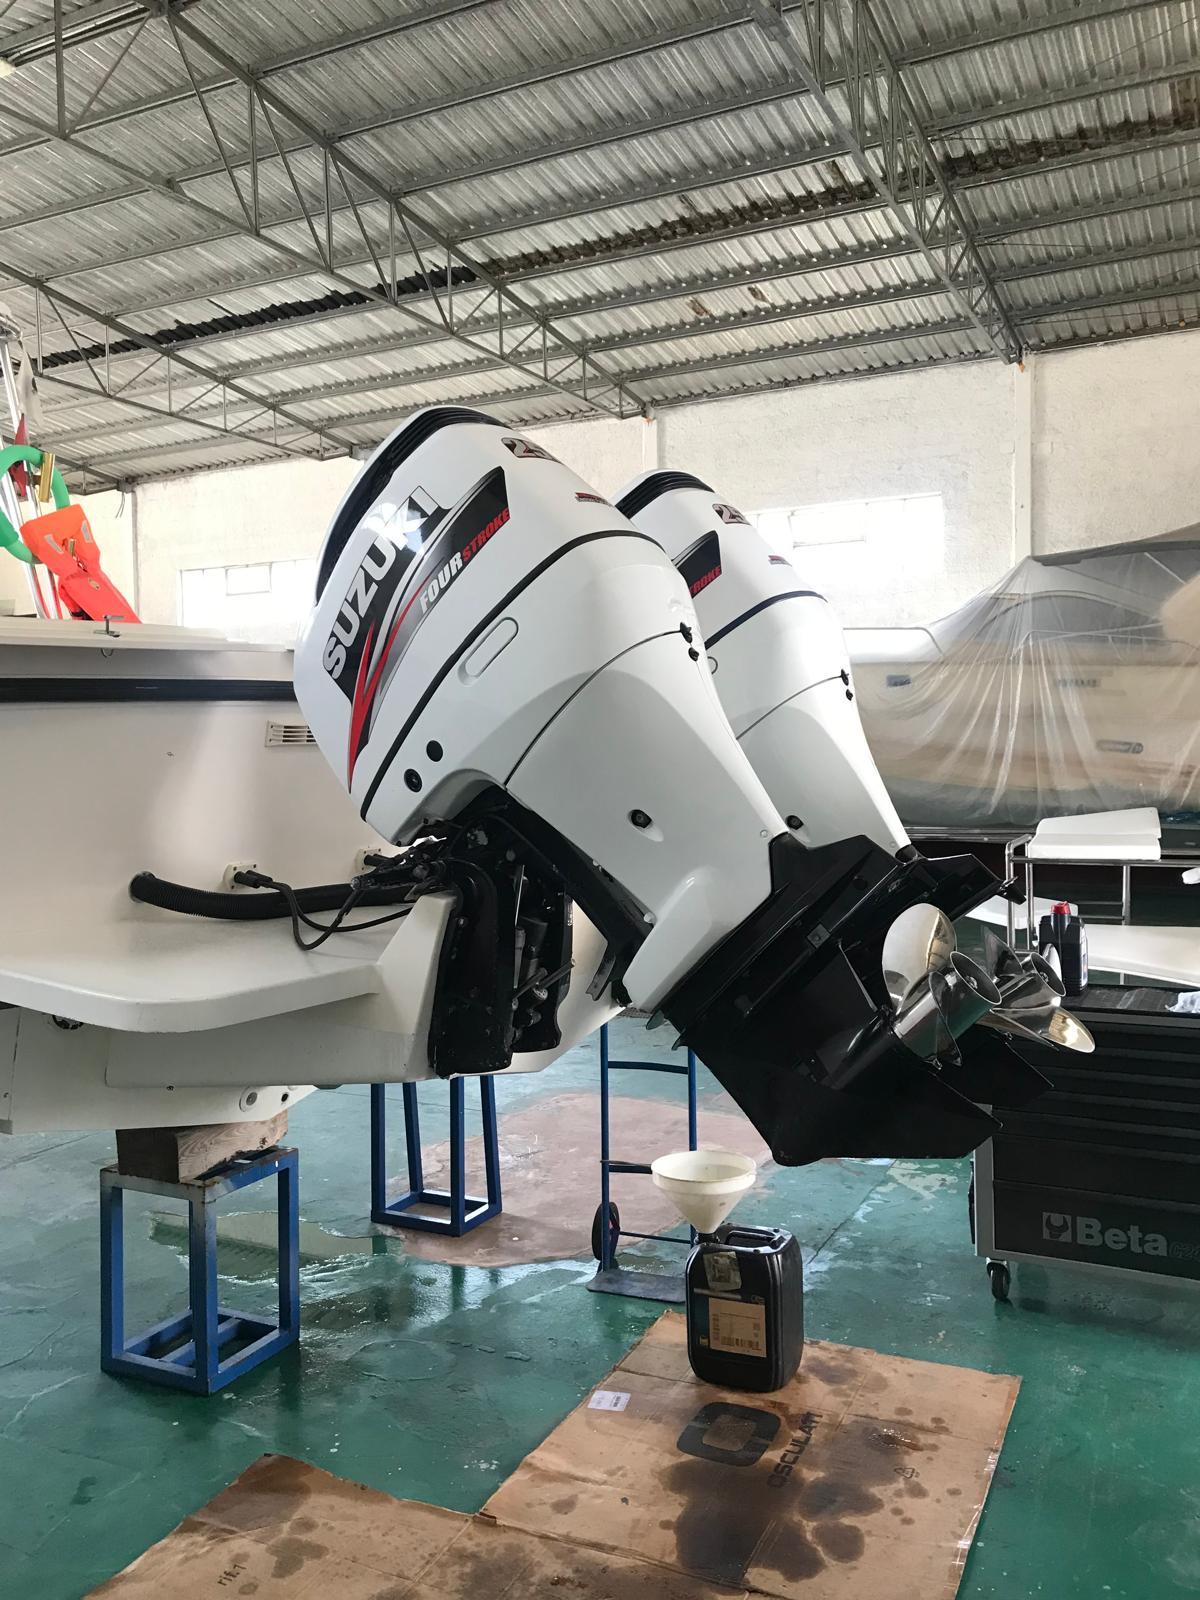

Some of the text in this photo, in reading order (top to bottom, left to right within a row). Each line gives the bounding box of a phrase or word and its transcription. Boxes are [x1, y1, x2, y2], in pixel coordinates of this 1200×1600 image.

[323, 486, 439, 679] SUZUKI
[420, 508, 510, 613] FOUR STROKE
[689, 565, 722, 594] ROKE
[1076, 1216, 1167, 1257] Beta
[767, 1411, 823, 1488] OSCULATI
